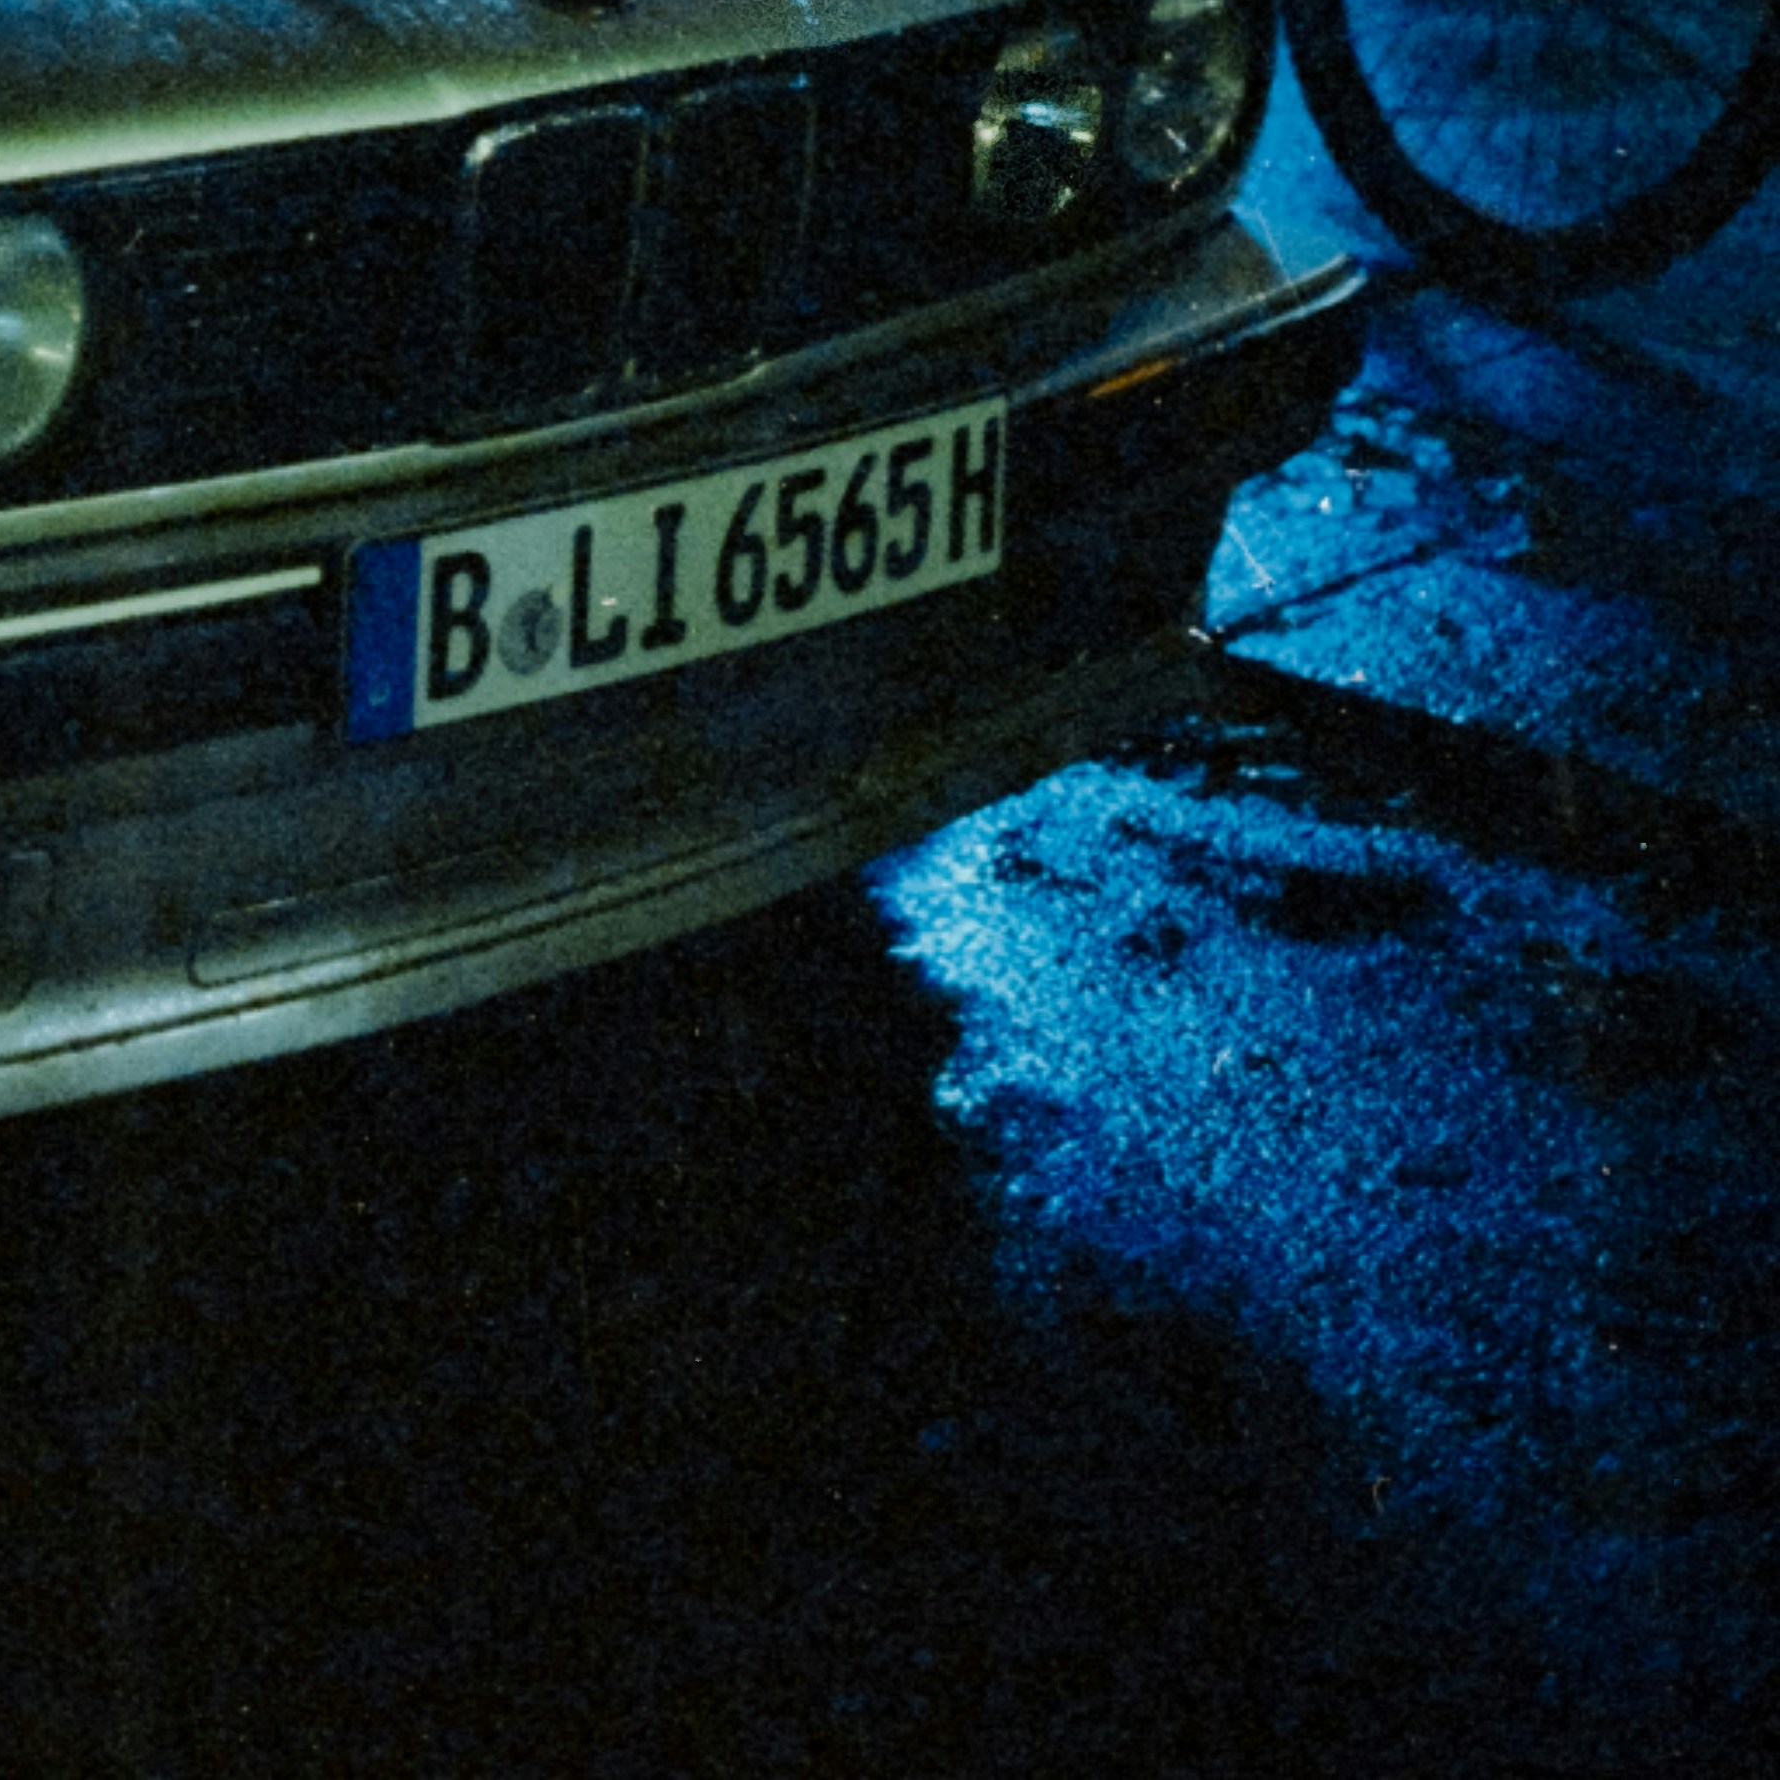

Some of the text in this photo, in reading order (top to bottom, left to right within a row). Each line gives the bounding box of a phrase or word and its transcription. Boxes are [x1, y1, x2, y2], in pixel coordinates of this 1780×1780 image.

[427, 416, 1001, 702] B LI 6565H
